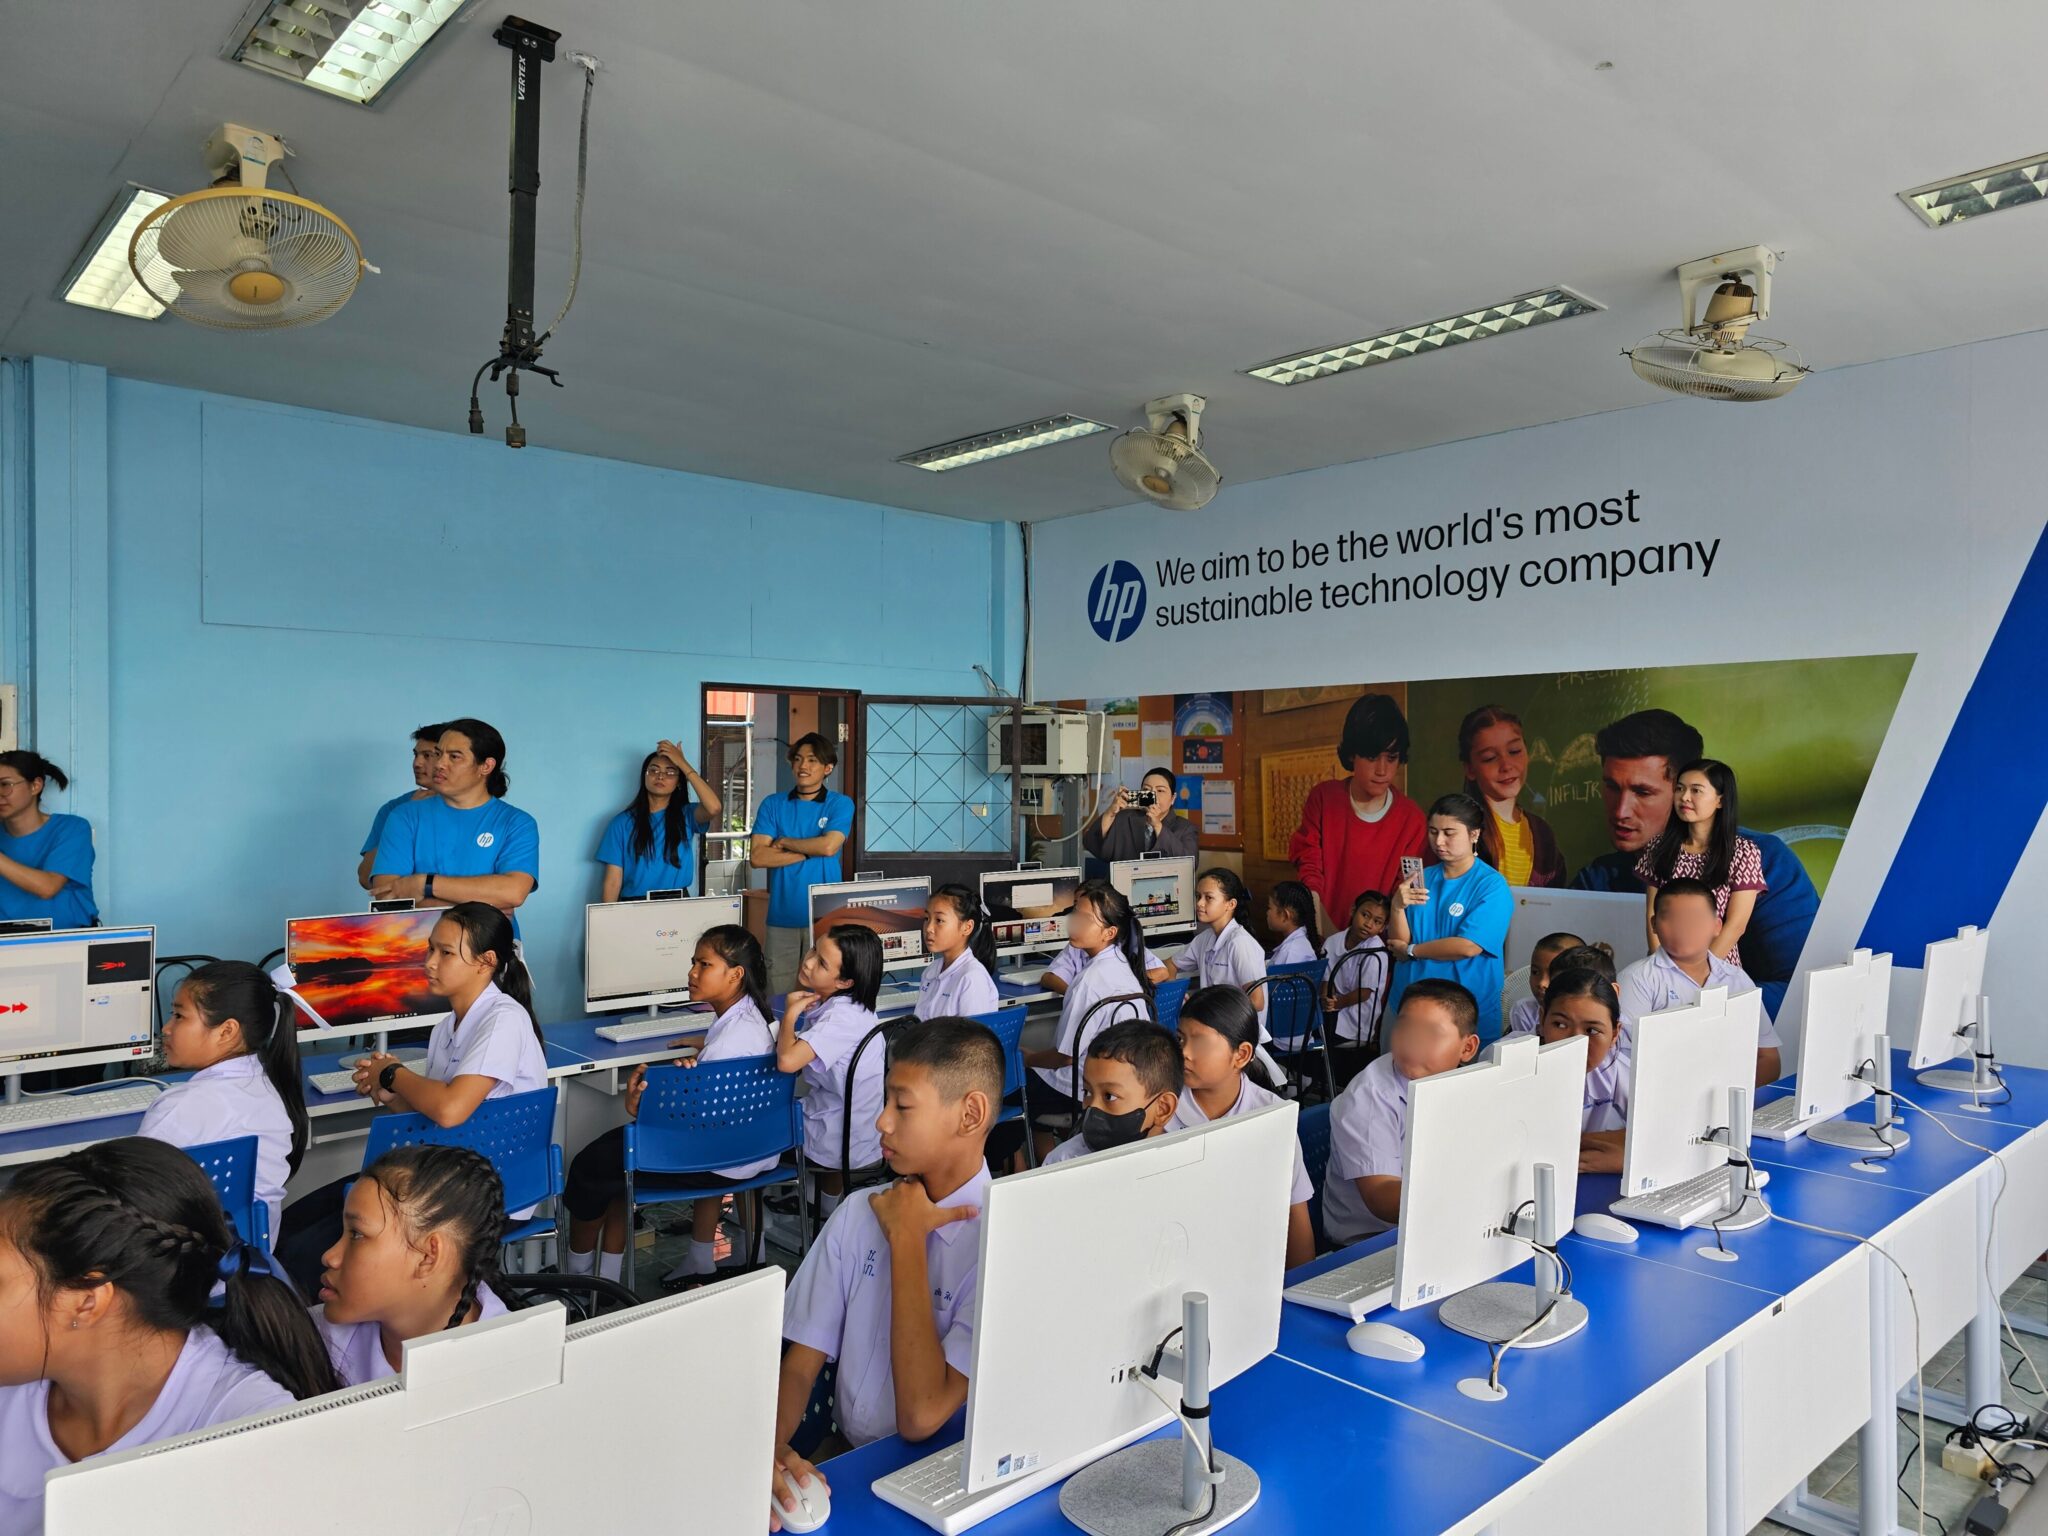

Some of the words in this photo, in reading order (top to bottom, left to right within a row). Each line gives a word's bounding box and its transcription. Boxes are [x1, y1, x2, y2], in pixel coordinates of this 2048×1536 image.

[518, 54, 526, 101] VERTEX
[1155, 557, 1196, 588] We
[1201, 551, 1250, 582] aim
[1256, 546, 1285, 574] to
[1292, 539, 1330, 570] be
[1336, 530, 1389, 563] the
[1396, 506, 1524, 555] world's
[1535, 488, 1641, 536] most
[1091, 560, 1143, 643] hp
[1155, 584, 1313, 628] sustainable
[1319, 564, 1511, 610] technology
[1519, 539, 1721, 588] company
[478, 832, 494, 847] hp
[1449, 903, 1464, 916] hp
